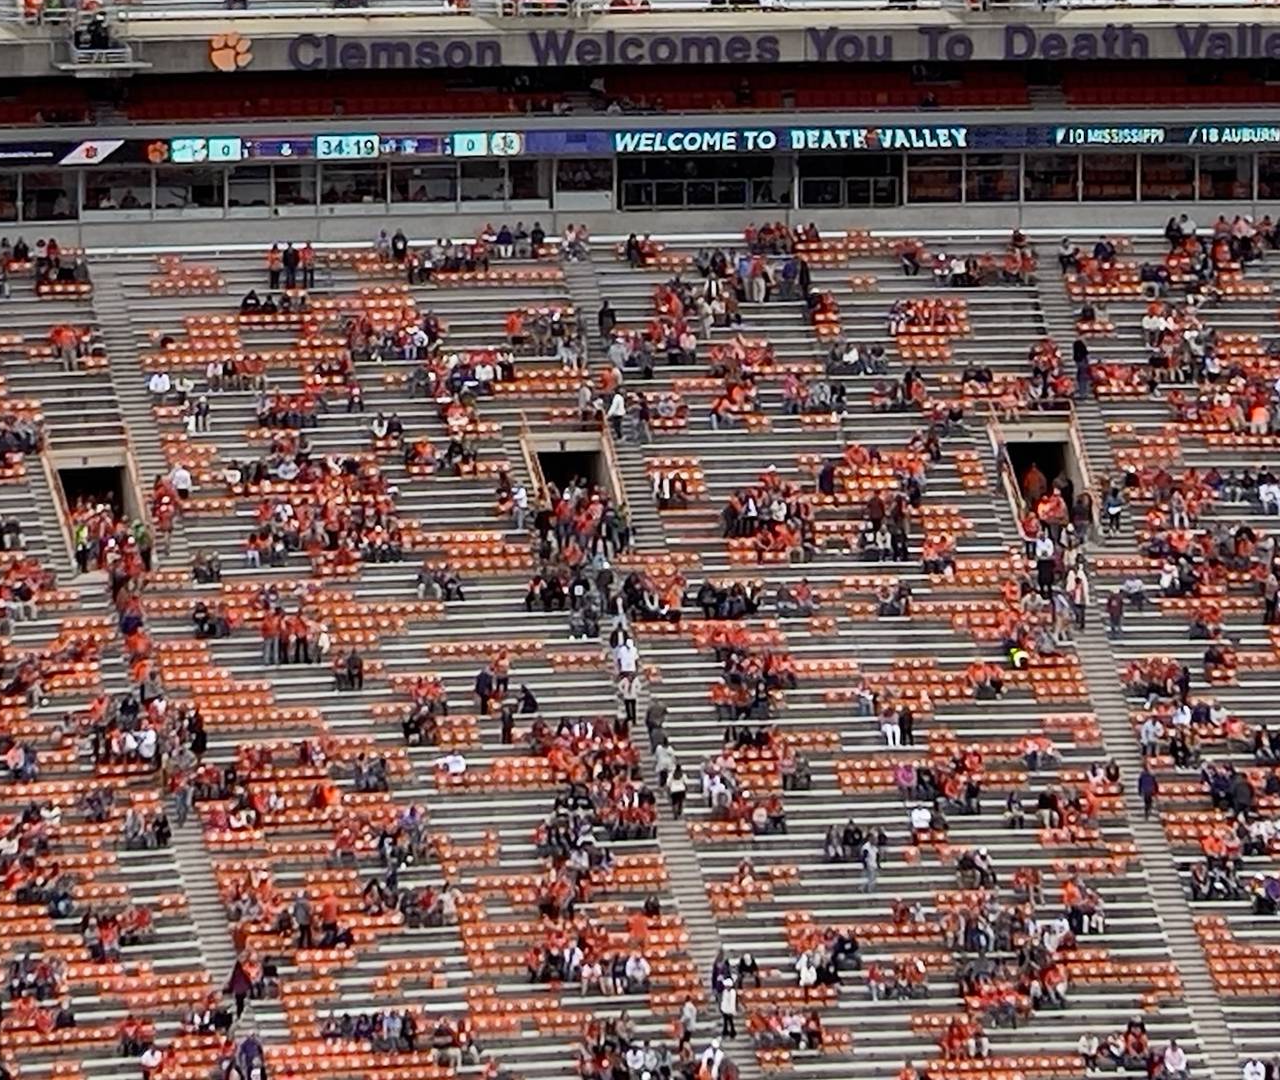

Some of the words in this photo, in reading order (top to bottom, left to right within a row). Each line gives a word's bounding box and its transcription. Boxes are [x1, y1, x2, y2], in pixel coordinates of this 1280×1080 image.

[288, 33, 503, 71] Clemson
[528, 29, 781, 66] Welcomes
[807, 26, 893, 62] You
[918, 26, 974, 61] To
[1003, 23, 1150, 61] Death
[322, 139, 375, 155] 34:19
[615, 131, 737, 151] WELCOME
[744, 131, 776, 150] TO
[791, 130, 868, 150] DEATH
[878, 128, 968, 149] VALLEY
